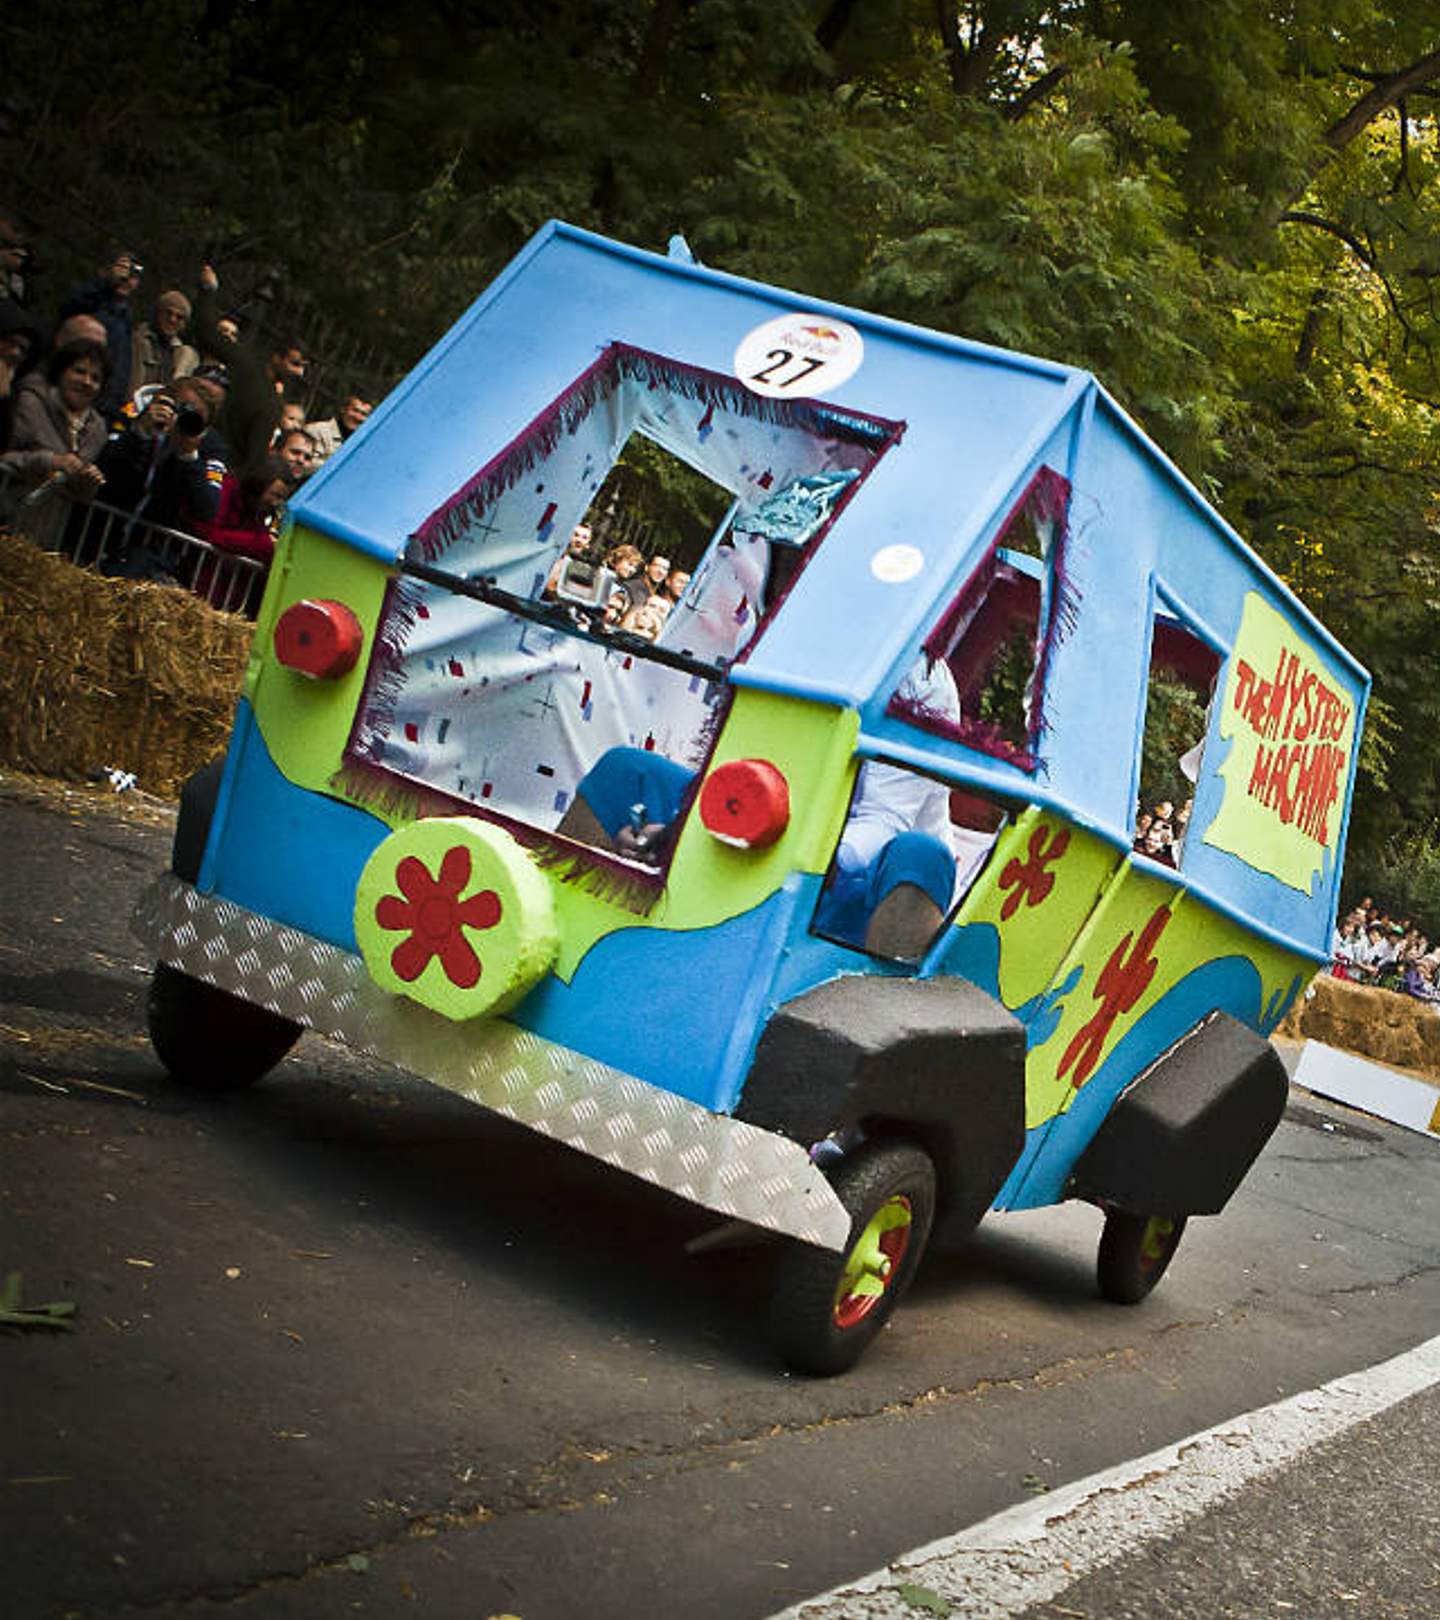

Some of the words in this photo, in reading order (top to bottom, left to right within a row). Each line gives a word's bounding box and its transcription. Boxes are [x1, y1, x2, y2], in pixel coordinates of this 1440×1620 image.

[750, 349, 825, 388] 27
[1234, 658, 1272, 738] THE
[1264, 646, 1350, 741] MYSTERY
[1248, 743, 1345, 847] MACHINE
